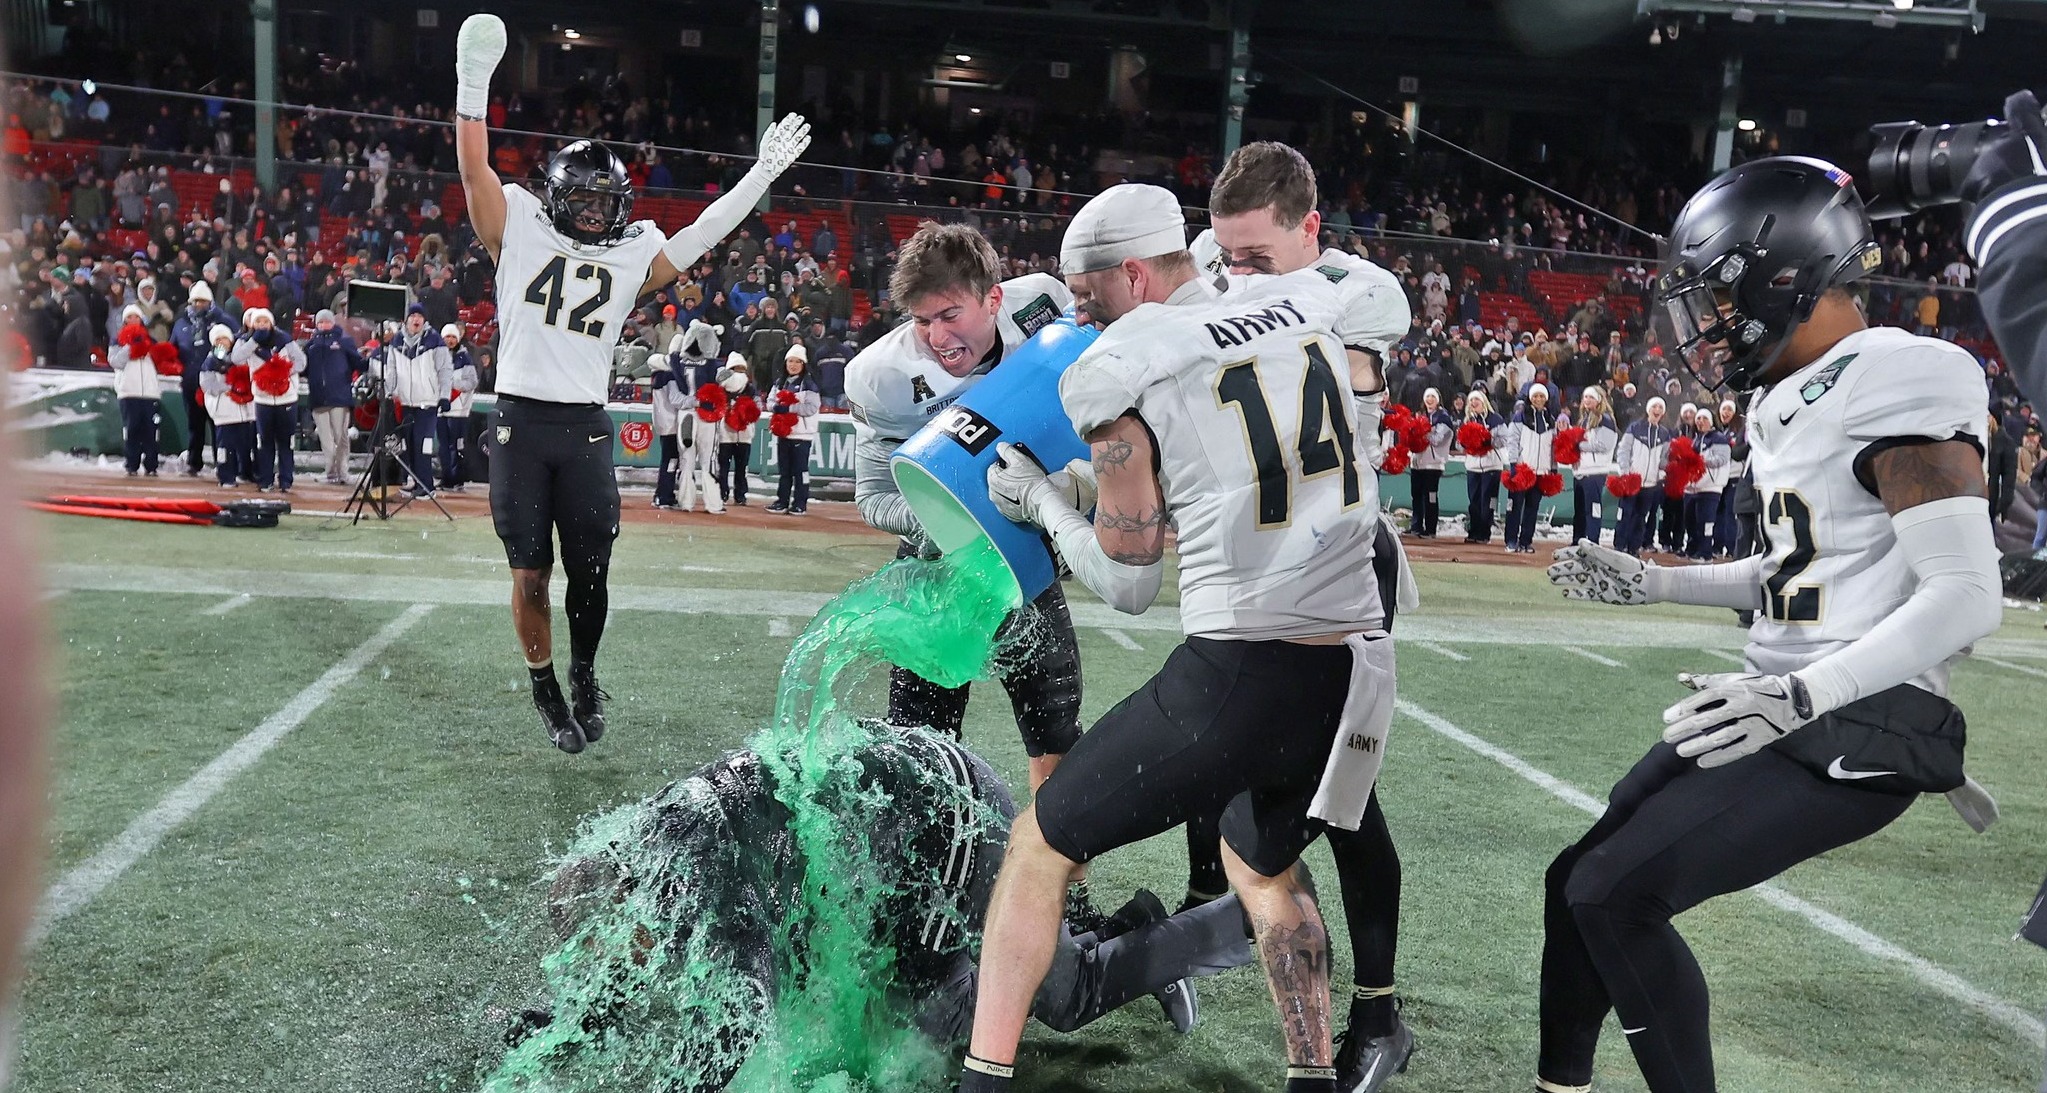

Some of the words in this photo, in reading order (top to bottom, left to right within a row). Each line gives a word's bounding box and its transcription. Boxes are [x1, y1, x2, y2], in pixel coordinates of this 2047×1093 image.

[524, 253, 613, 339] 42
[1205, 300, 1306, 349] ARMY
[1211, 335, 1365, 531] 14
[1756, 487, 1825, 625] 2
[1347, 733, 1378, 754] ARMY
[986, 1065, 1012, 1075] NIKE
